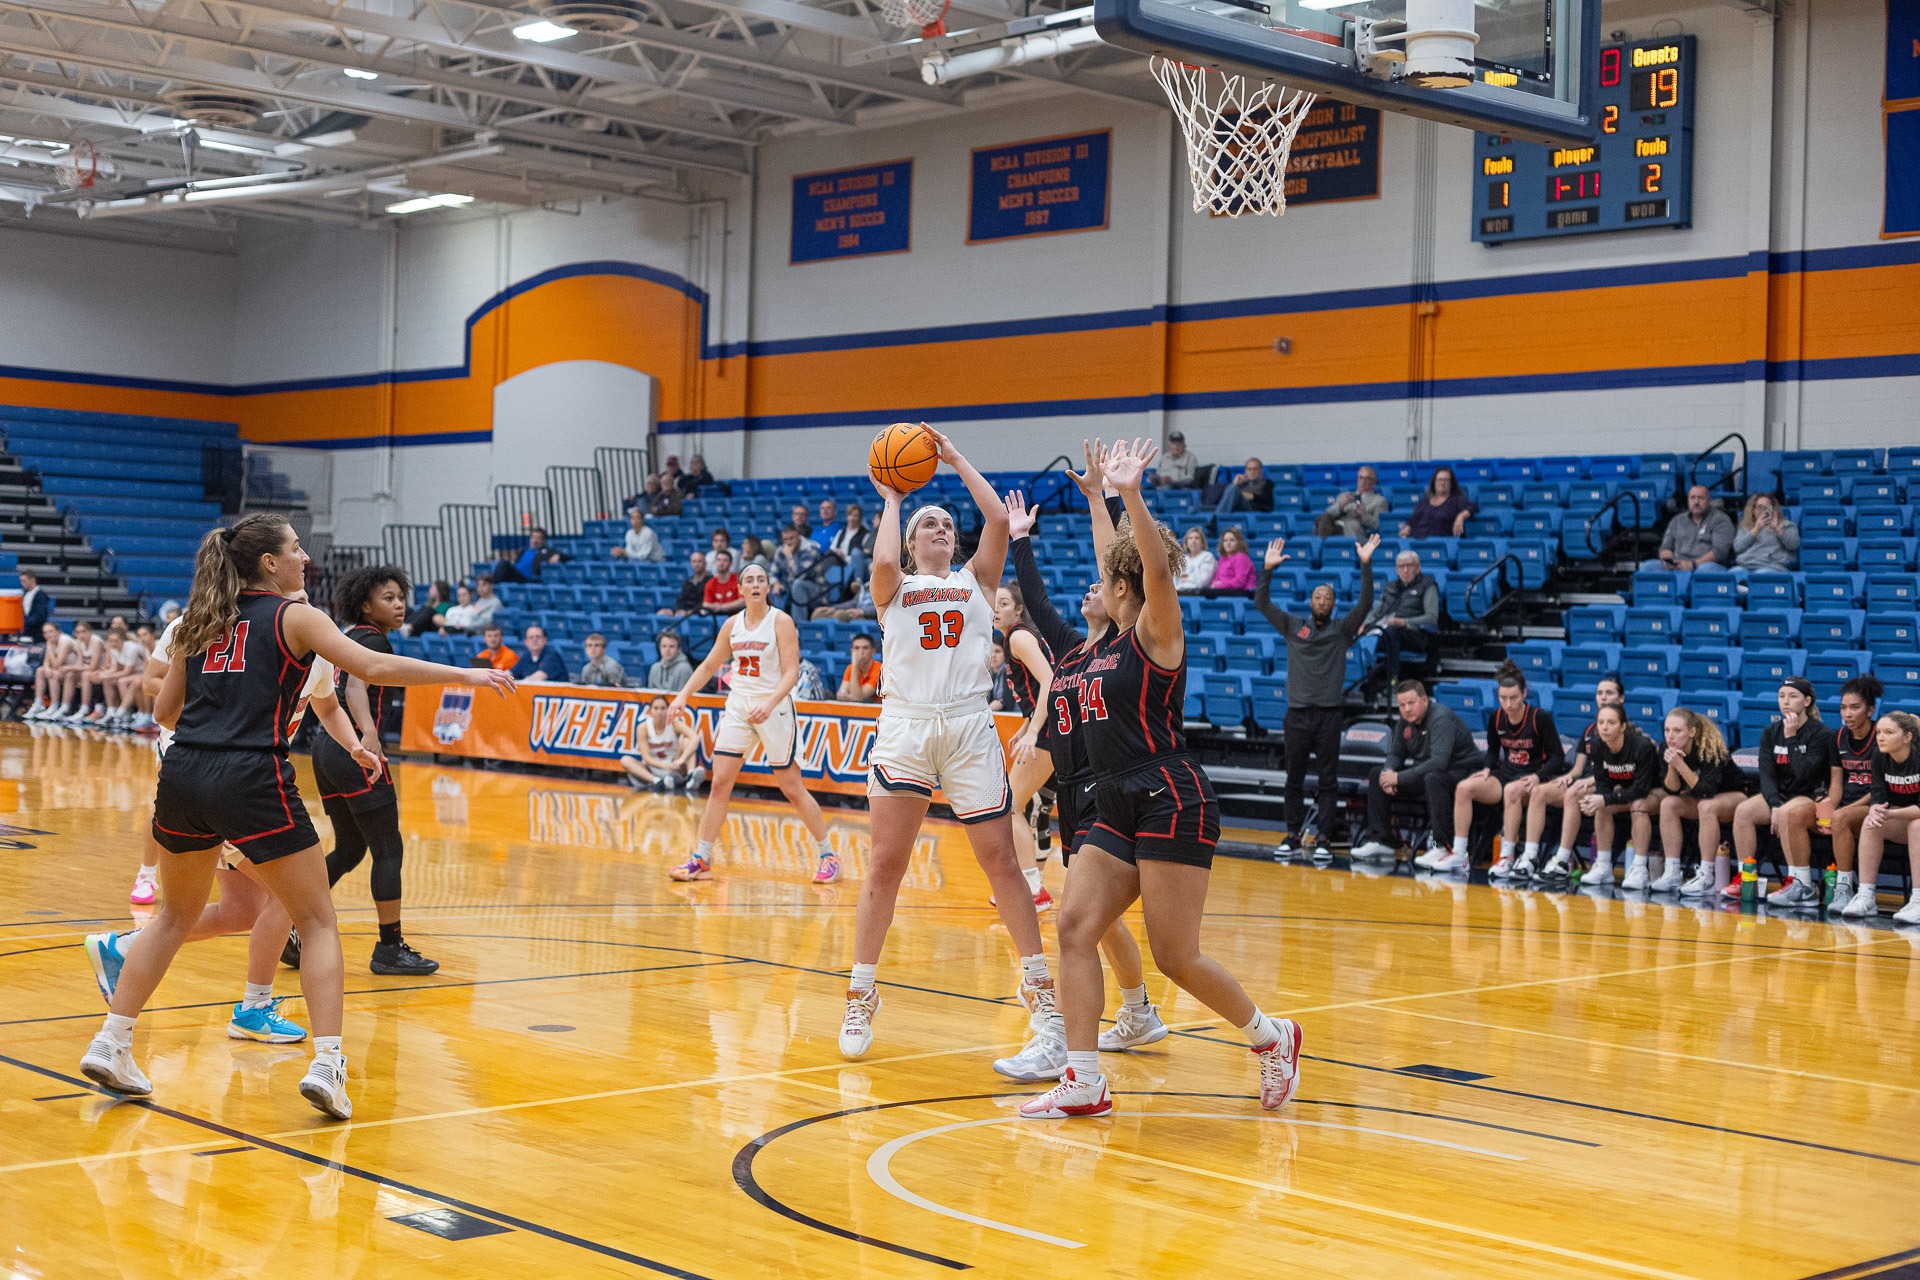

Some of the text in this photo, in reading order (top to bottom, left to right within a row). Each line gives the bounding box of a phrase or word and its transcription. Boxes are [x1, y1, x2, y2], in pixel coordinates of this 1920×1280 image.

[1633, 45, 1679, 67] Guests
[1484, 70, 1518, 87] Home
[1650, 68, 1678, 108] 19
[1603, 105, 1618, 134] 2
[1290, 124, 1367, 151] EMIFINALIST
[1636, 137, 1667, 158] fouls
[1286, 148, 1361, 174] ASKETBALL
[1484, 156, 1513, 175] fouls
[1553, 147, 1594, 168] player
[1007, 167, 1070, 189] CHAMPIONS
[1645, 163, 1661, 193] 2
[998, 186, 1079, 210] MEN'S SOCCER
[1502, 182, 1509, 207] 1
[1556, 210, 1588, 229] game
[1630, 203, 1656, 218] won
[1486, 217, 1509, 232] won
[902, 587, 973, 608] WHEATON
[918, 609, 965, 651] 33
[202, 620, 250, 674] 21
[737, 655, 760, 678] 25
[1078, 676, 1109, 723] 24
[1055, 696, 1073, 735] 3
